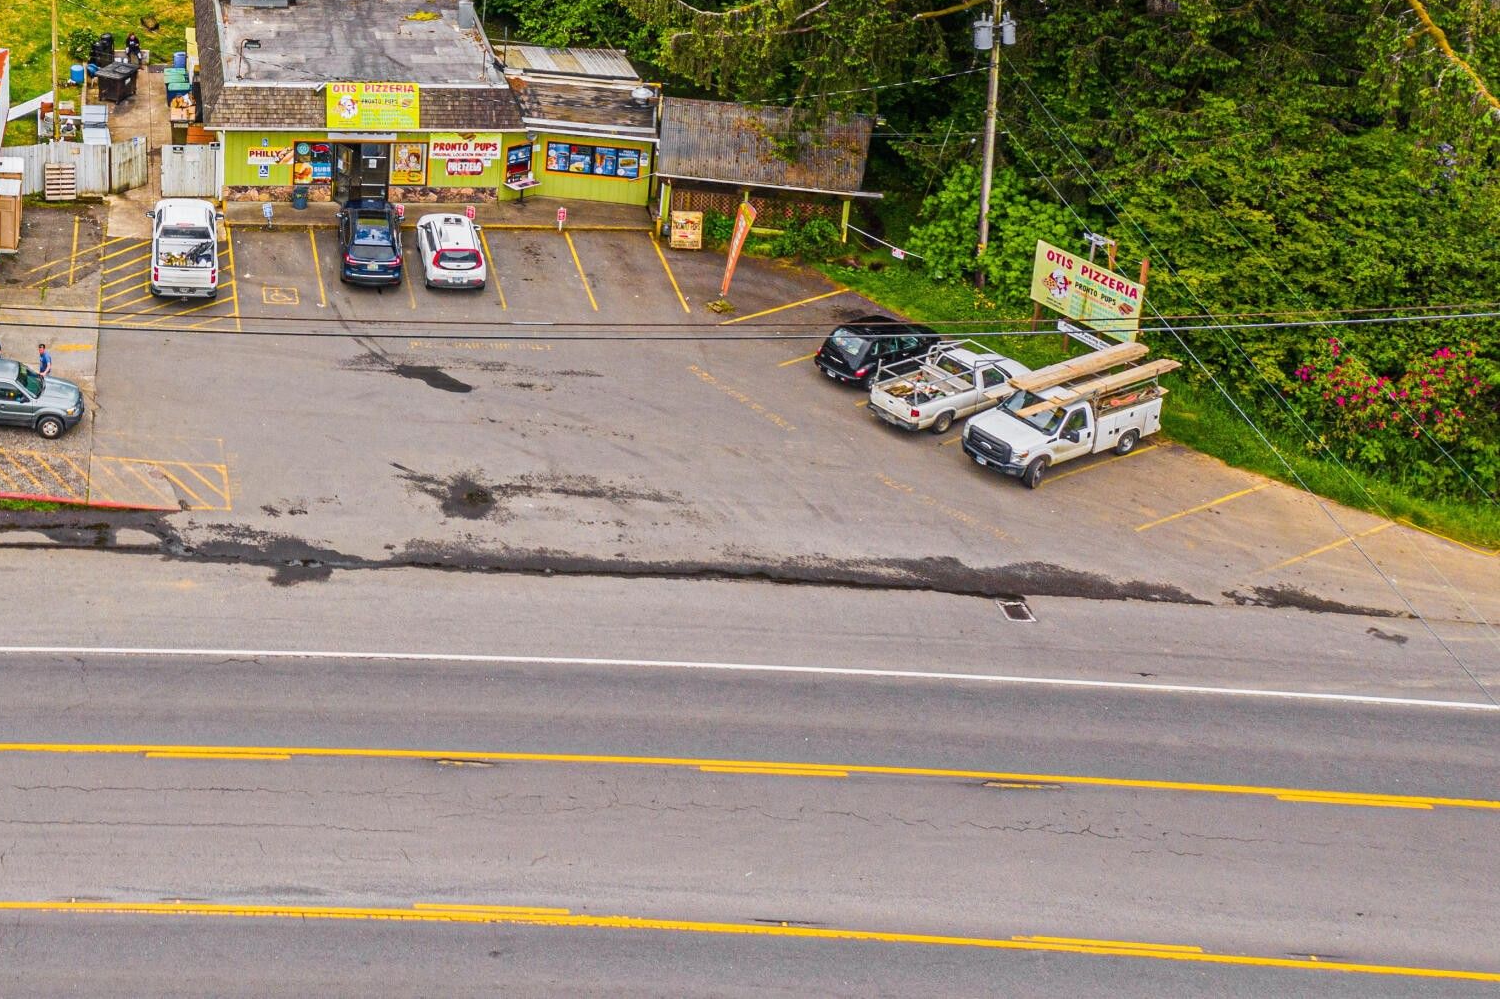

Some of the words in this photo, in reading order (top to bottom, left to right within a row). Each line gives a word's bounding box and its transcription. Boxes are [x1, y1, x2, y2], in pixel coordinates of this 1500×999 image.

[332, 84, 357, 93] OTIS
[364, 84, 415, 93] PIZZERIA
[433, 142, 469, 151] PRONTO
[473, 142, 498, 152] PUPS
[249, 150, 281, 158] PHILLY
[1046, 249, 1074, 270] OTIS
[1081, 264, 1138, 300] PIZZERIA
[1074, 281, 1098, 297] PRONTO
[1100, 293, 1117, 306] PUPS
